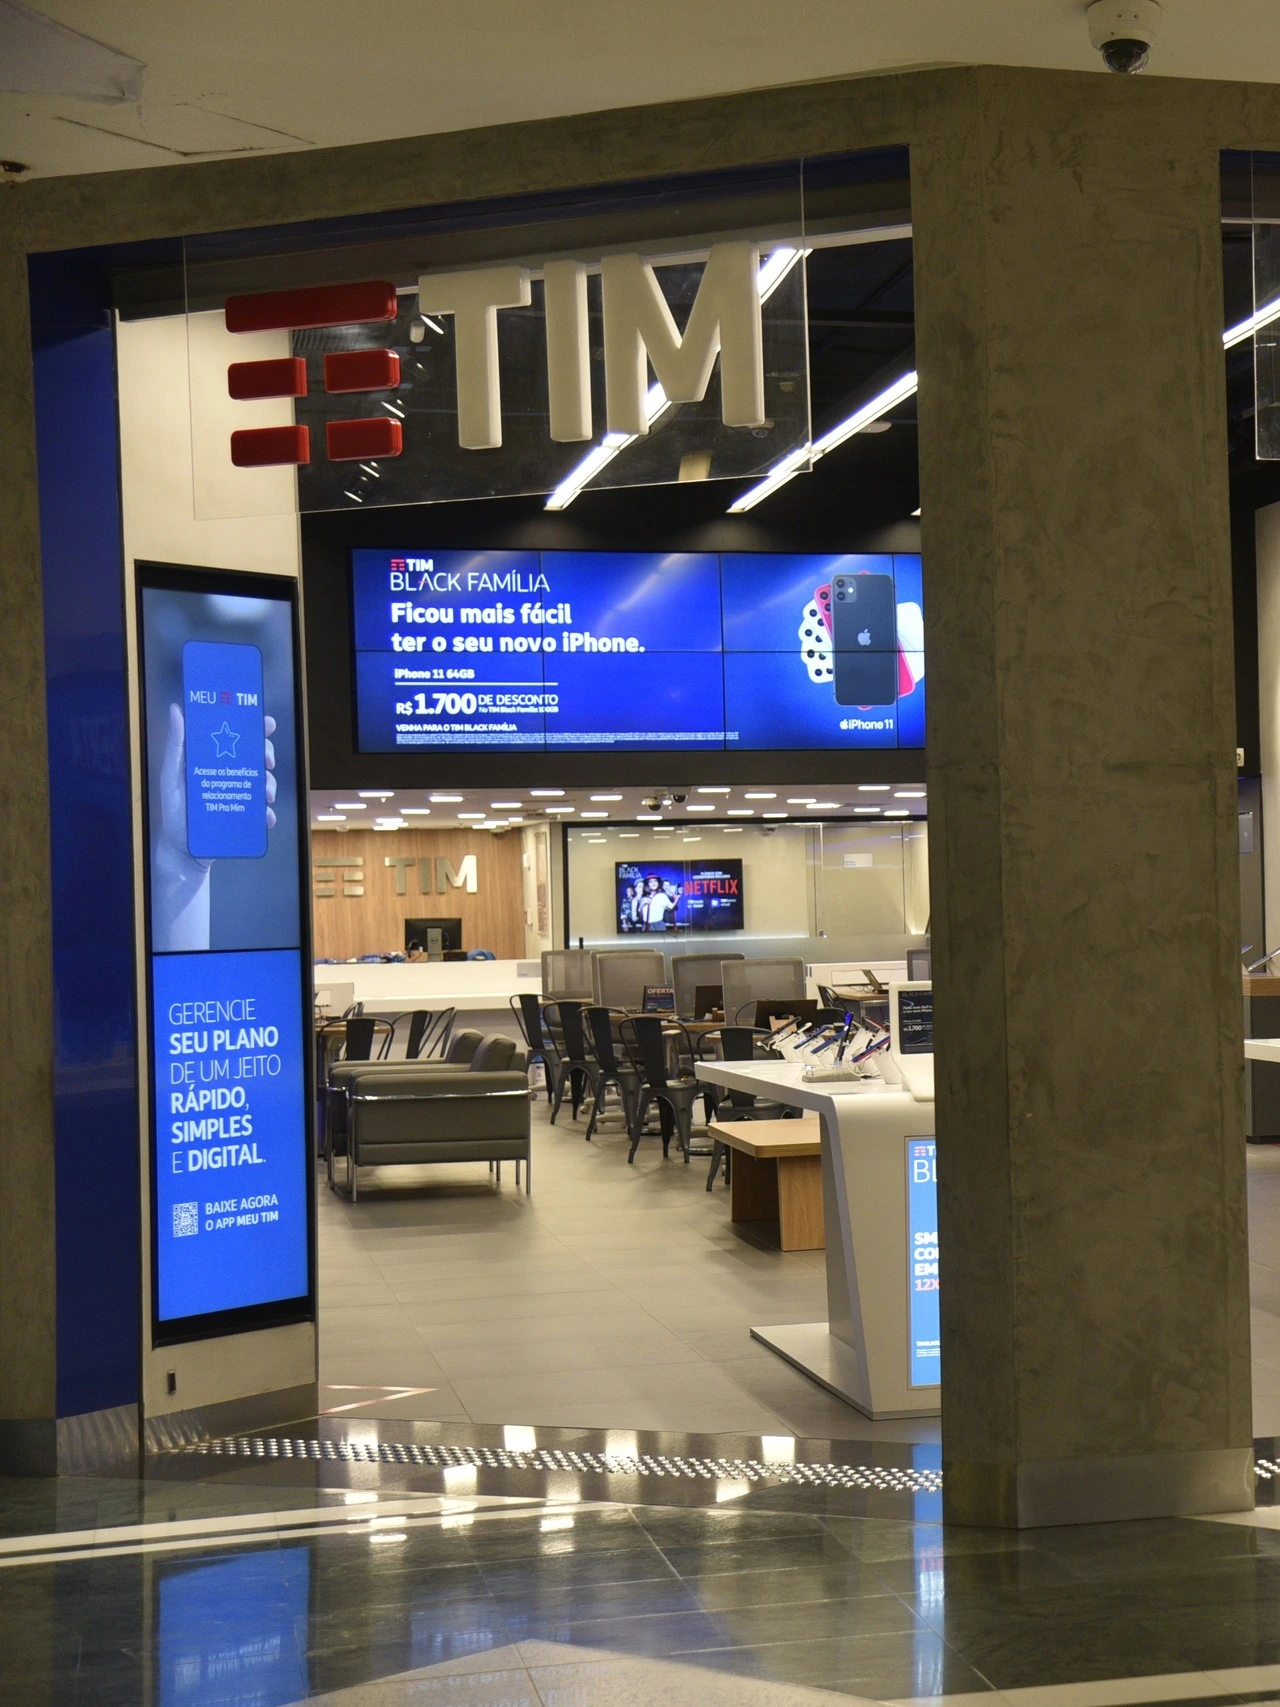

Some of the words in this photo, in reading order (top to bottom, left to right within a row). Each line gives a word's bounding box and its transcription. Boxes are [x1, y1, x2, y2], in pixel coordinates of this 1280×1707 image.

[418, 240, 766, 450] TIM
[405, 558, 434, 572] TIM
[390, 572, 462, 592] BLACK
[468, 569, 551, 593] FAMÍLIA
[391, 602, 454, 624] Ficou
[460, 602, 515, 624] mais
[520, 603, 572, 624] fácil
[391, 632, 427, 653] ter
[432, 637, 447, 653] o
[453, 636, 494, 653] seu
[499, 635, 557, 653] novo
[562, 631, 646, 653] iPhone.
[394, 668, 431, 679] iPhone
[432, 669, 445, 679] 11
[446, 669, 476, 679] 64GB
[190, 690, 217, 704] MEU
[236, 693, 258, 706] TIM
[396, 701, 413, 716] R$
[414, 693, 477, 715] 1.700
[478, 694, 494, 705] DE
[496, 694, 559, 705] DESCONTO
[423, 724, 443, 732] PARA
[849, 719, 883, 730] iPhone
[885, 719, 894, 730] 11
[206, 803, 218, 812] TIM
[384, 855, 478, 895] TIM
[684, 879, 739, 896] NETFLIX
[169, 999, 256, 1026] GERENCIE
[169, 1030, 208, 1055] SEU
[213, 1026, 279, 1052] PLANO
[171, 1061, 195, 1085] DE
[200, 1058, 230, 1082] UM
[234, 1054, 281, 1079] JEITO
[171, 1084, 249, 1114] RÁPIDO,
[171, 1114, 253, 1144] SIMPLES
[172, 1151, 183, 1174] E
[188, 1142, 266, 1172] DIGITAL.
[205, 1199, 238, 1215] BAIXE
[240, 1194, 278, 1210] AGORA
[205, 1220, 214, 1231] O
[216, 1217, 235, 1229] APP
[237, 1213, 259, 1226] MEU
[261, 1210, 279, 1222] TIM
[914, 1231, 938, 1246] SM
